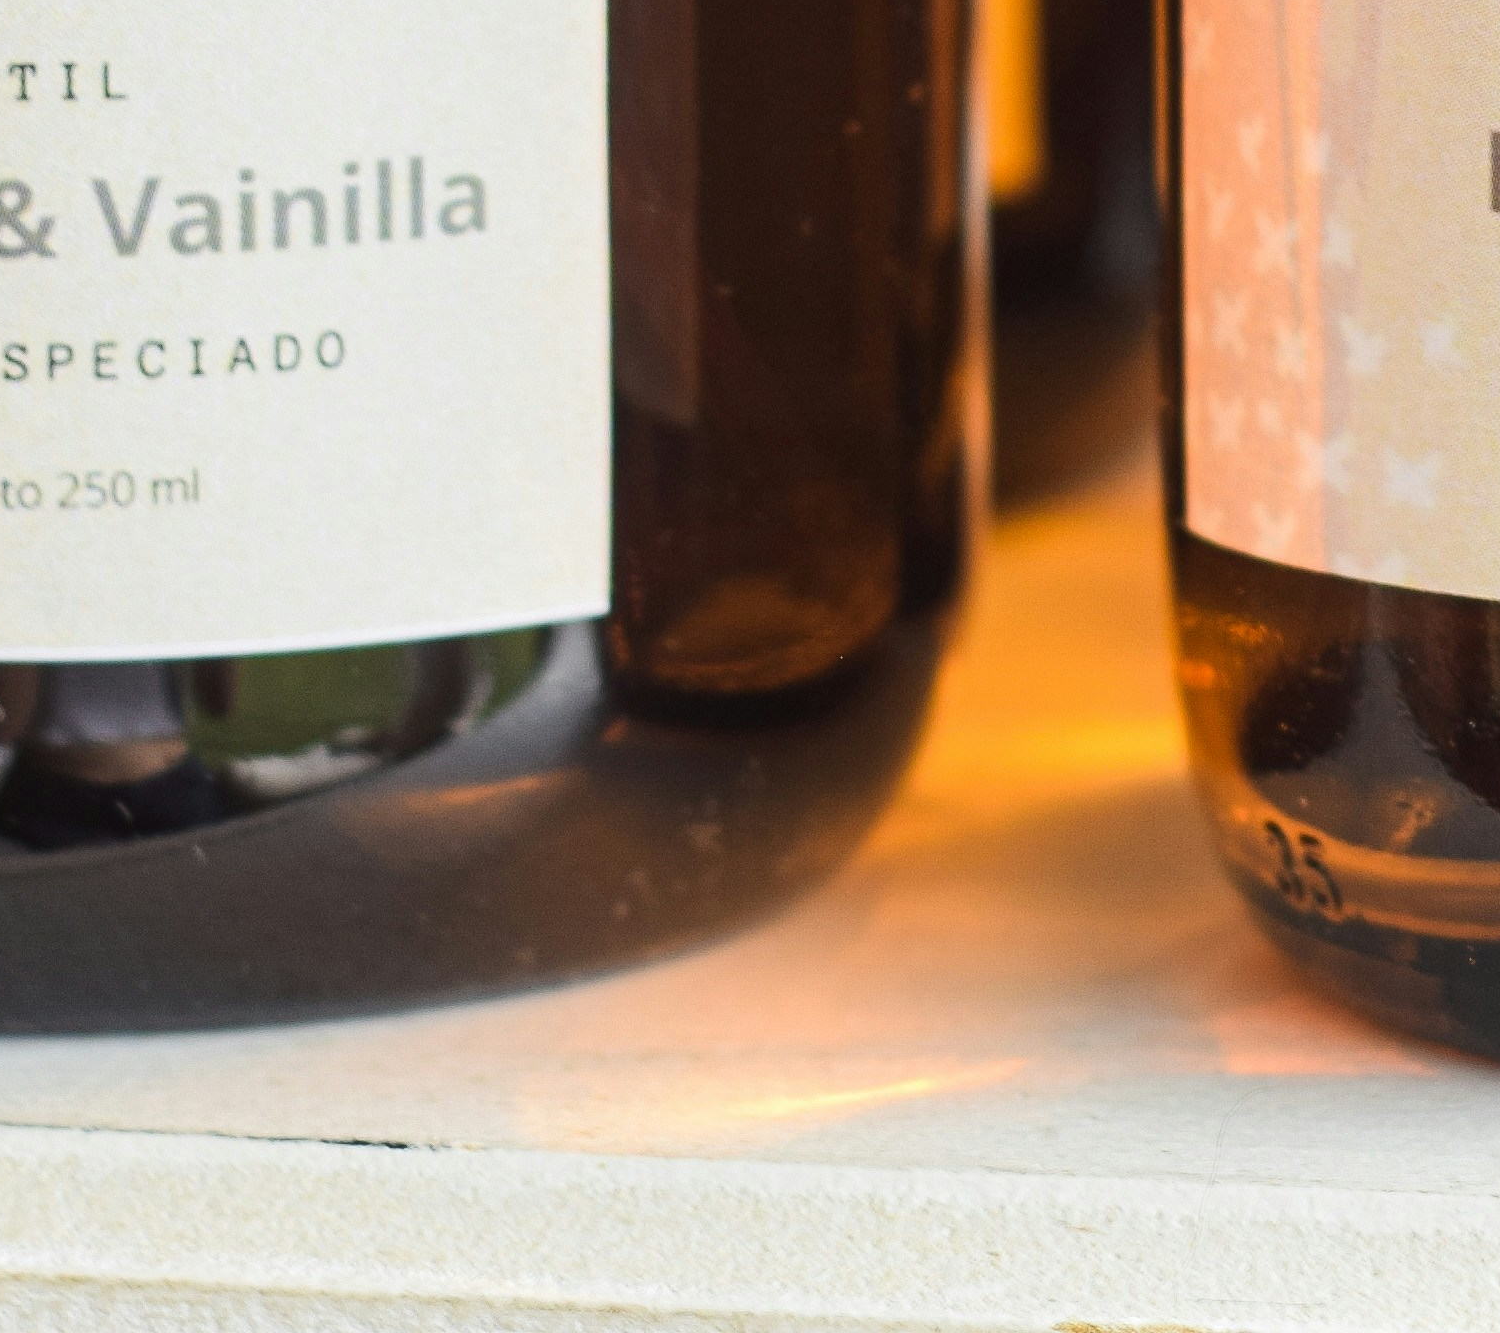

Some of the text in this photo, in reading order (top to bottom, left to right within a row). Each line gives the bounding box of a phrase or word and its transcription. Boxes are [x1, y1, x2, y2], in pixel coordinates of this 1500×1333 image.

[91, 155, 487, 258] Vainilla
[55, 468, 138, 512] 250
[148, 466, 202, 507] ml
